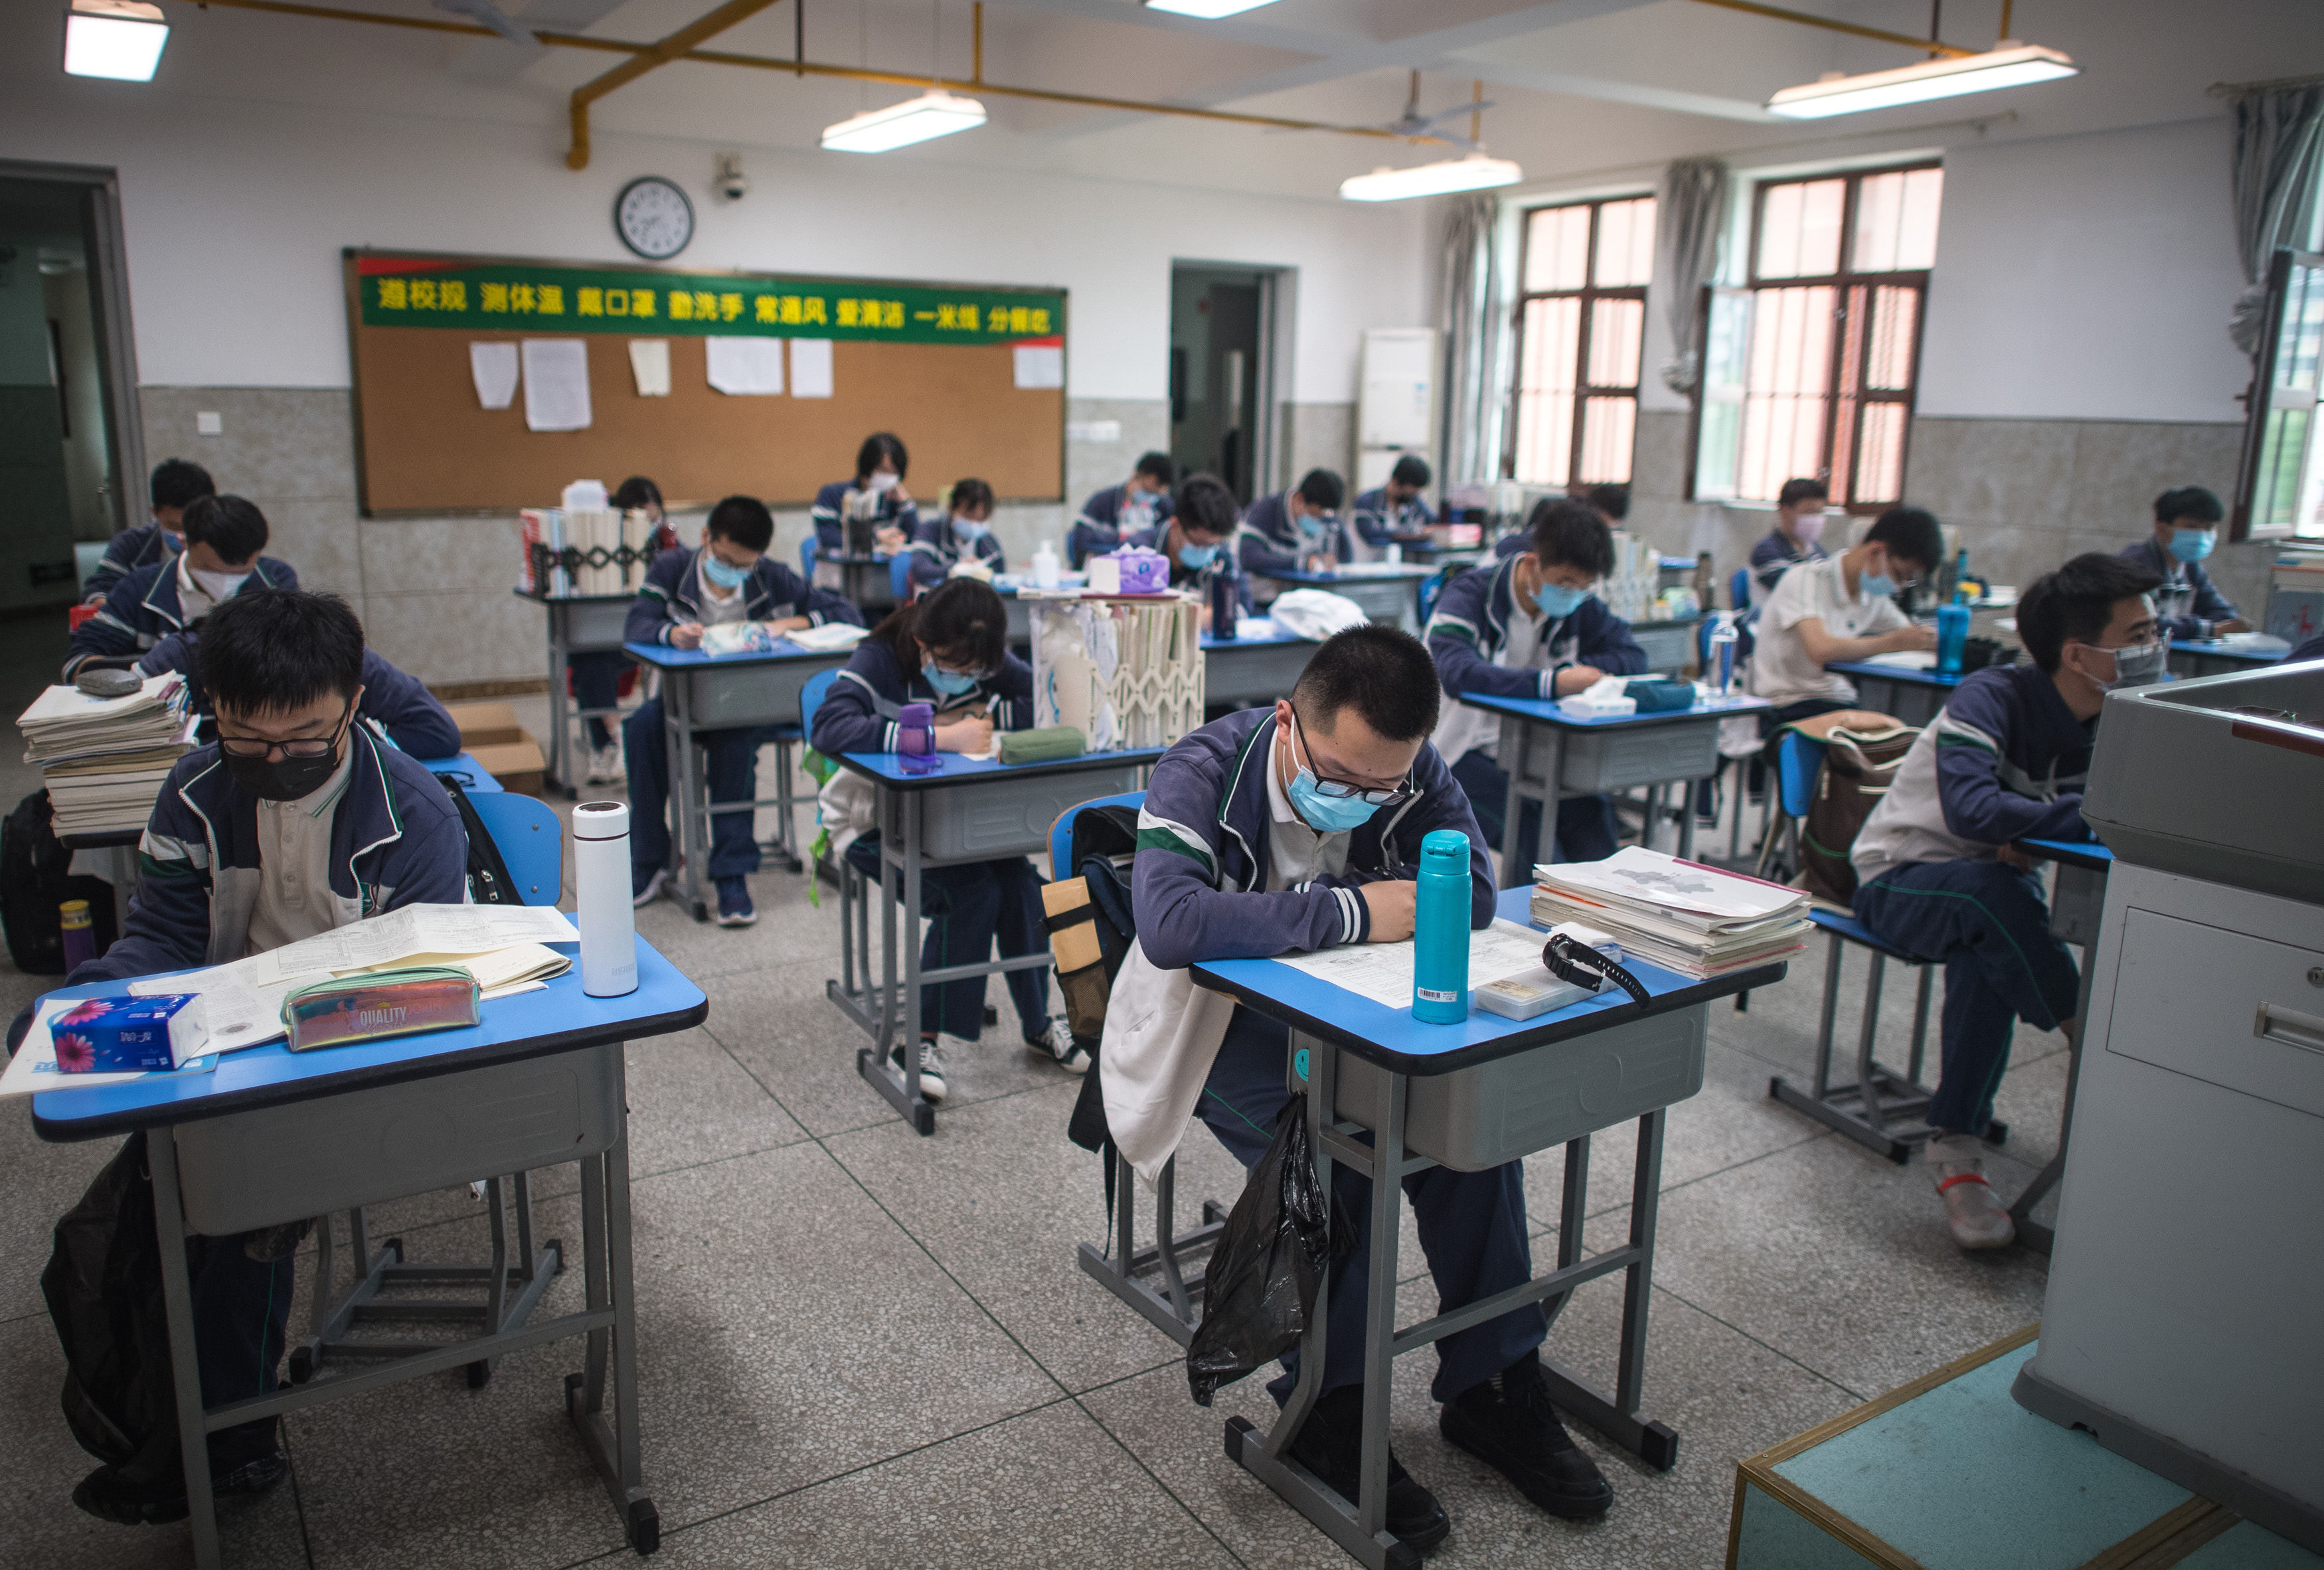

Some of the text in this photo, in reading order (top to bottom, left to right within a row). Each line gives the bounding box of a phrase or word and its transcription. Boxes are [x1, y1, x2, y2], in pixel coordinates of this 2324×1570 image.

[481, 283, 564, 314] 测体温
[577, 287, 655, 317] 戴口罩
[669, 291, 743, 321] 勤洗手
[754, 295, 827, 325] 常通风
[836, 298, 904, 328] 爱清洁
[360, 1006, 407, 1026] QUALITY
